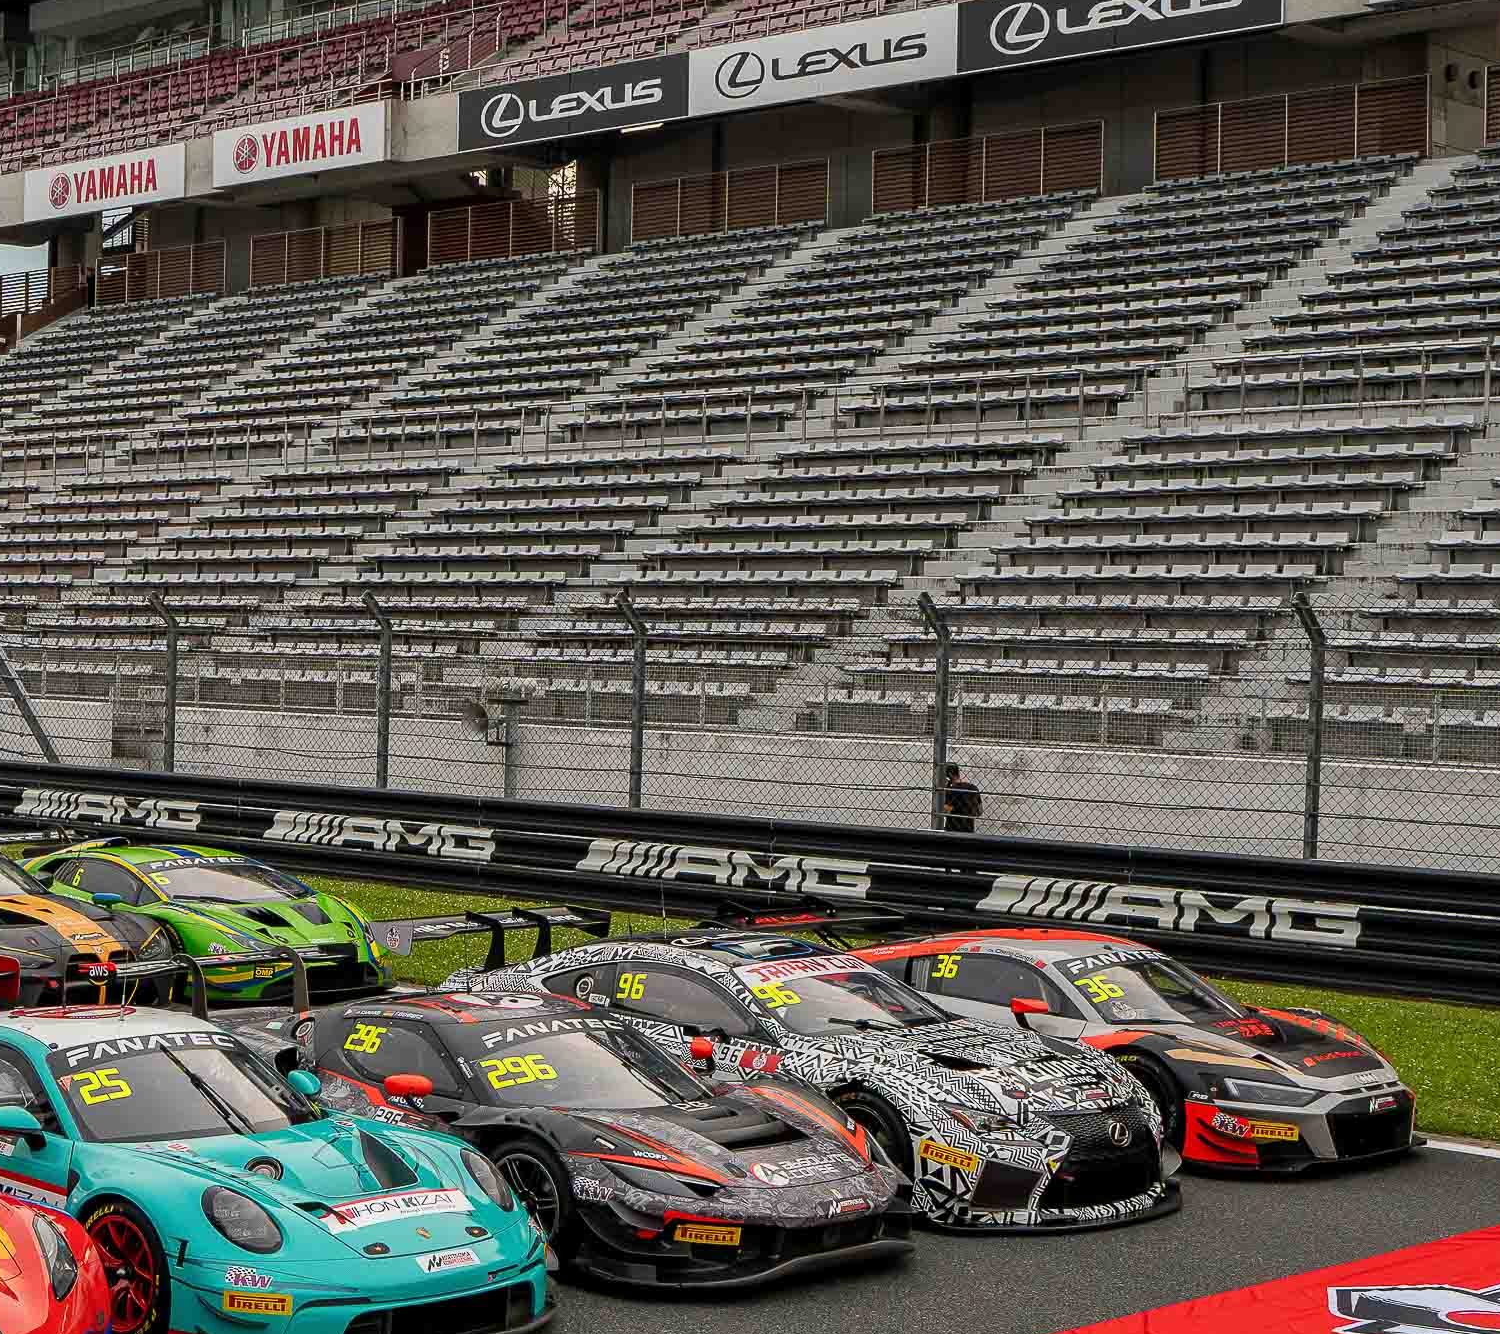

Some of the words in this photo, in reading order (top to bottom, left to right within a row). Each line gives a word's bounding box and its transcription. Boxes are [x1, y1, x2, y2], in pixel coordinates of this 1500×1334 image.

[770, 31, 928, 78] LEXUS
[527, 77, 664, 117] LEXUS
[262, 116, 363, 167] YAMAHA
[74, 157, 159, 205] YAMAHA
[85, 794, 202, 832] AMG
[340, 817, 495, 864] AMG
[150, 855, 247, 870] FANATEC
[662, 847, 870, 900] AMG
[72, 869, 83, 887] 6
[1102, 885, 1361, 949] AMG
[88, 964, 109, 977] aws
[254, 968, 274, 977] OMP
[931, 954, 962, 978] 36
[1066, 948, 1170, 975] FANATEC
[616, 972, 648, 1001] 96
[751, 982, 801, 1009] 96
[1074, 975, 1125, 1004] 36
[343, 1023, 390, 1055] 296
[481, 1018, 624, 1049] FANATEC
[67, 1032, 236, 1068] FANATEC
[720, 1044, 745, 1064] 96
[72, 1067, 133, 1106] 25
[480, 1054, 560, 1090] 296
[1252, 1125, 1297, 1140] PIRELLI
[924, 1145, 975, 1168] PIRELLI
[680, 1227, 736, 1242] PIRELLI
[228, 1295, 290, 1312] PIRELLI
